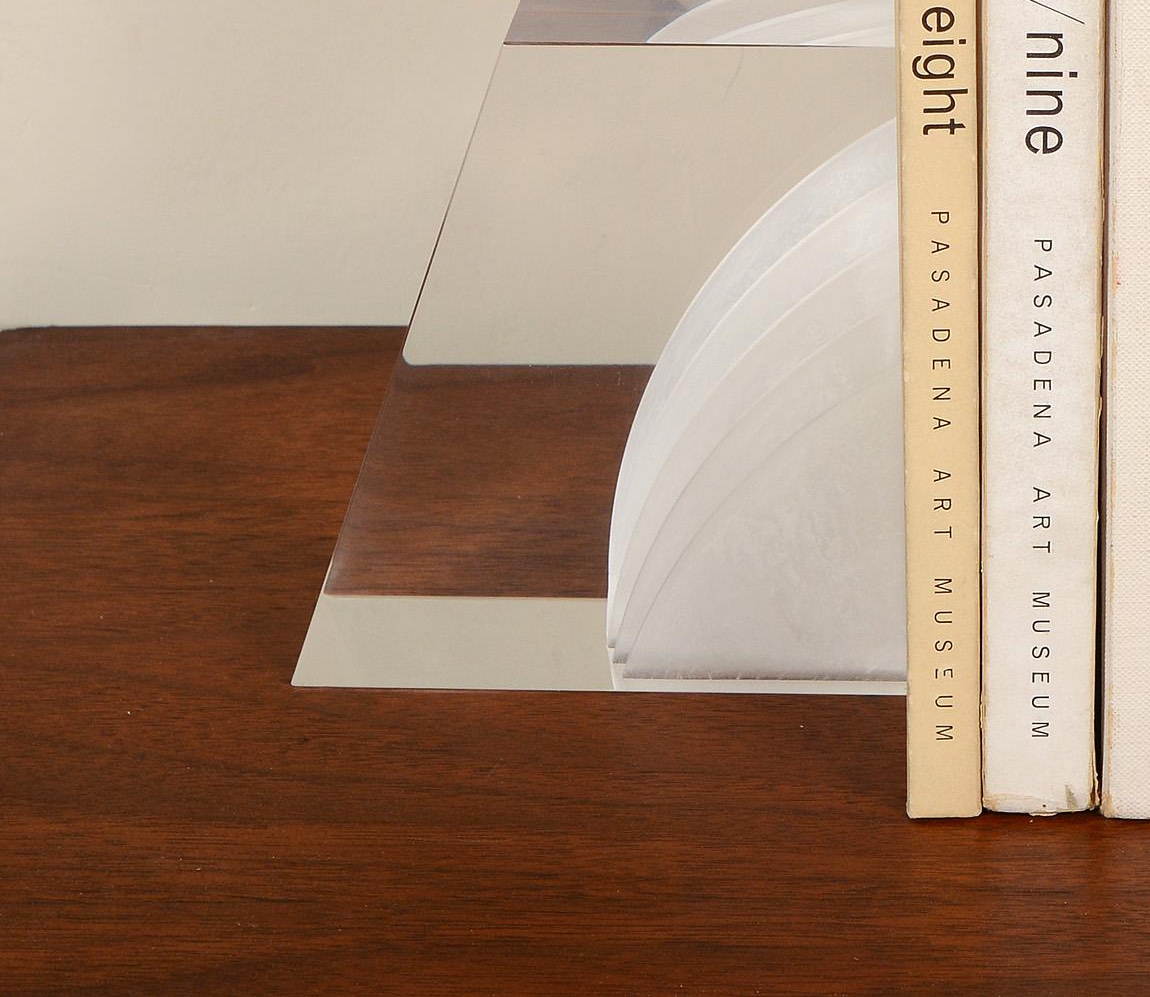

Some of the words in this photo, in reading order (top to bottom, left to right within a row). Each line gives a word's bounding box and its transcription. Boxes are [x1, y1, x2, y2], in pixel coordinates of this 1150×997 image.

[930, 210, 952, 431] PASADENA
[1032, 238, 1053, 448] PASADENA
[932, 468, 953, 539] ART
[1032, 486, 1052, 554] ART
[933, 577, 954, 742] MUSEUM
[1031, 591, 1051, 738] MUSEUM
